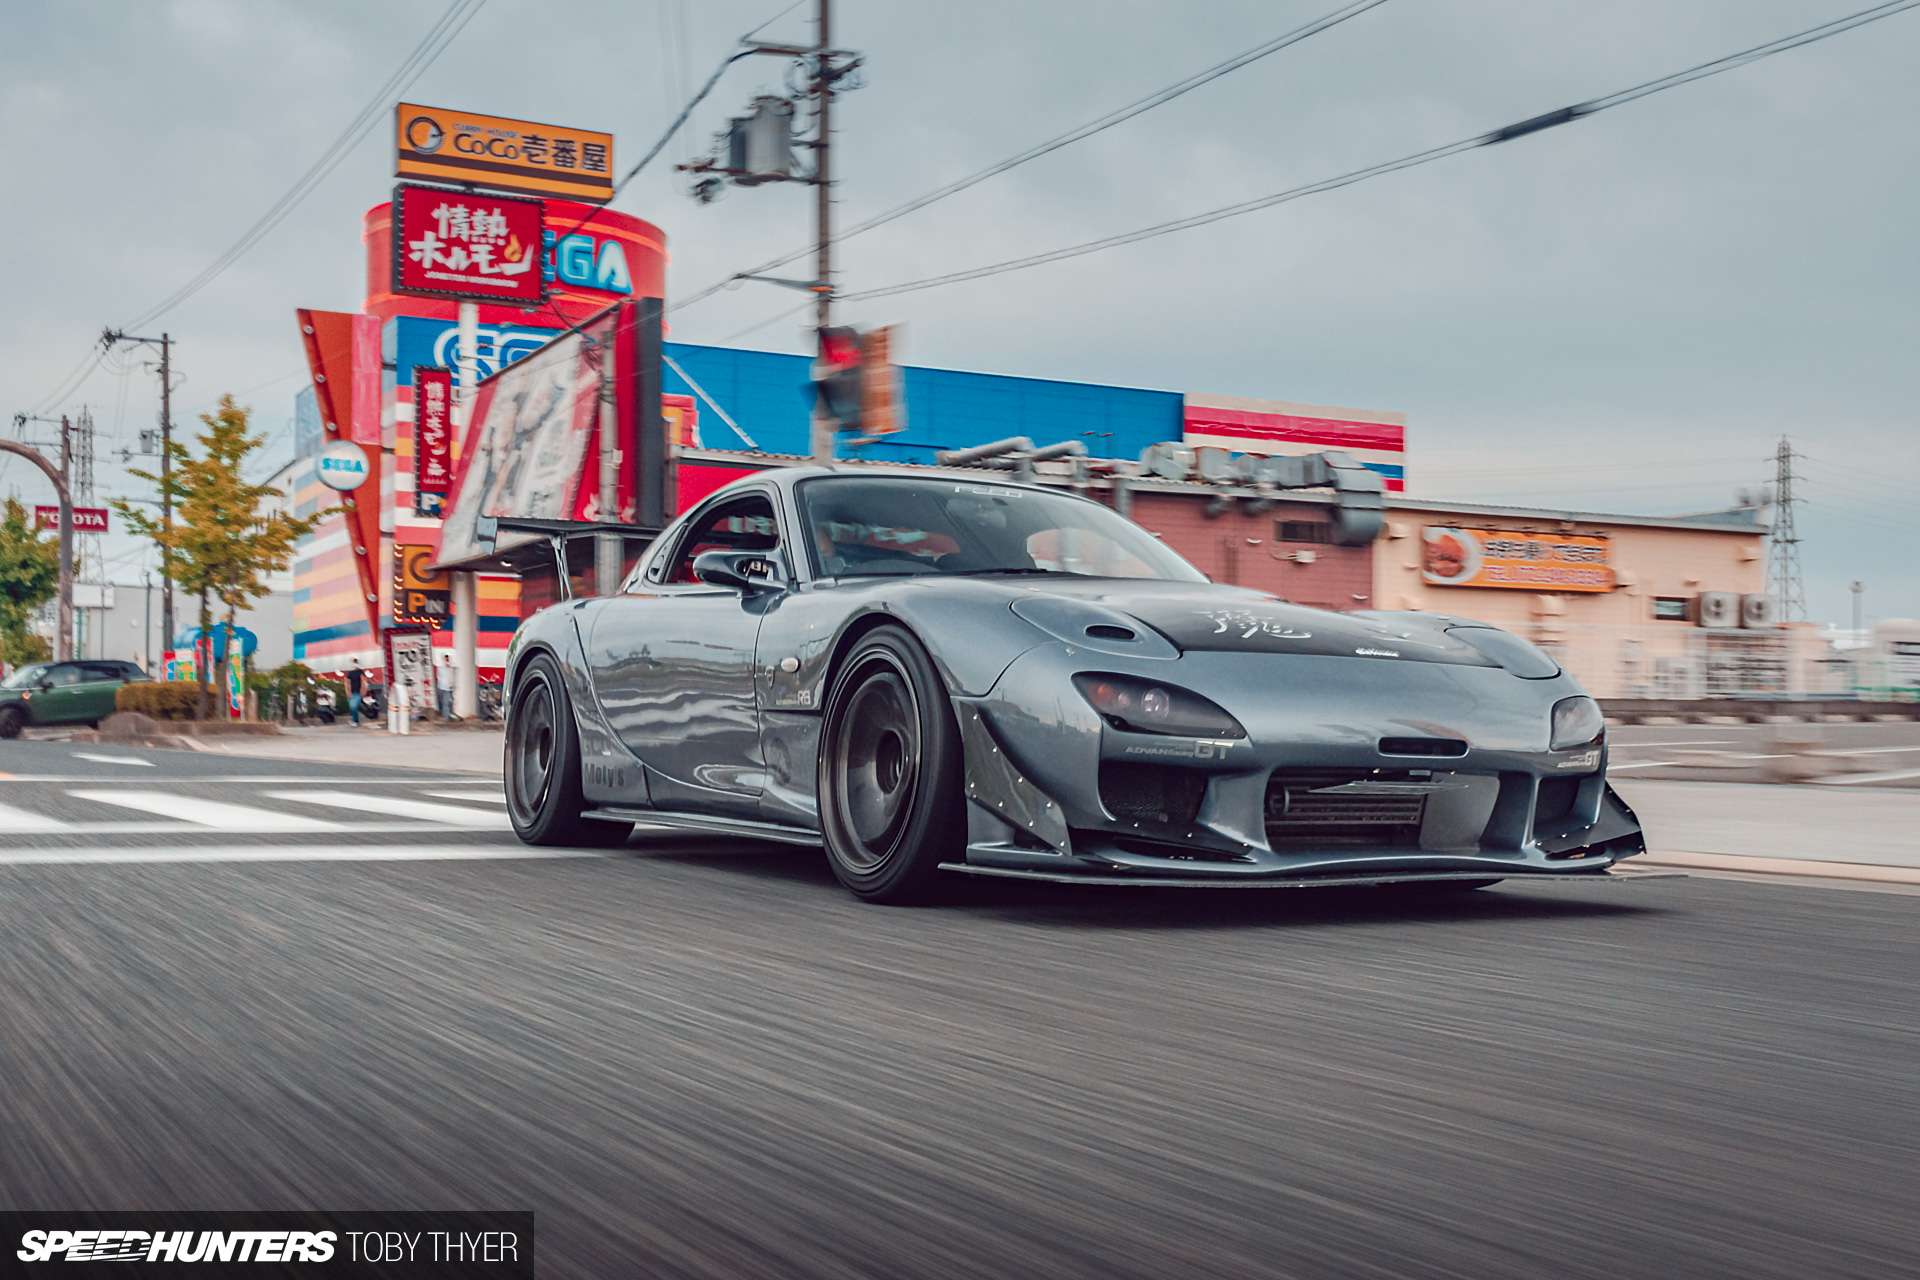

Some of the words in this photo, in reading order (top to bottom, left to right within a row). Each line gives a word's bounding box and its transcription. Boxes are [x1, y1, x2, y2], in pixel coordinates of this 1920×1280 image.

[430, 202, 510, 246] 情熱
[38, 511, 105, 526] TOOTA
[1195, 740, 1235, 760] GT
